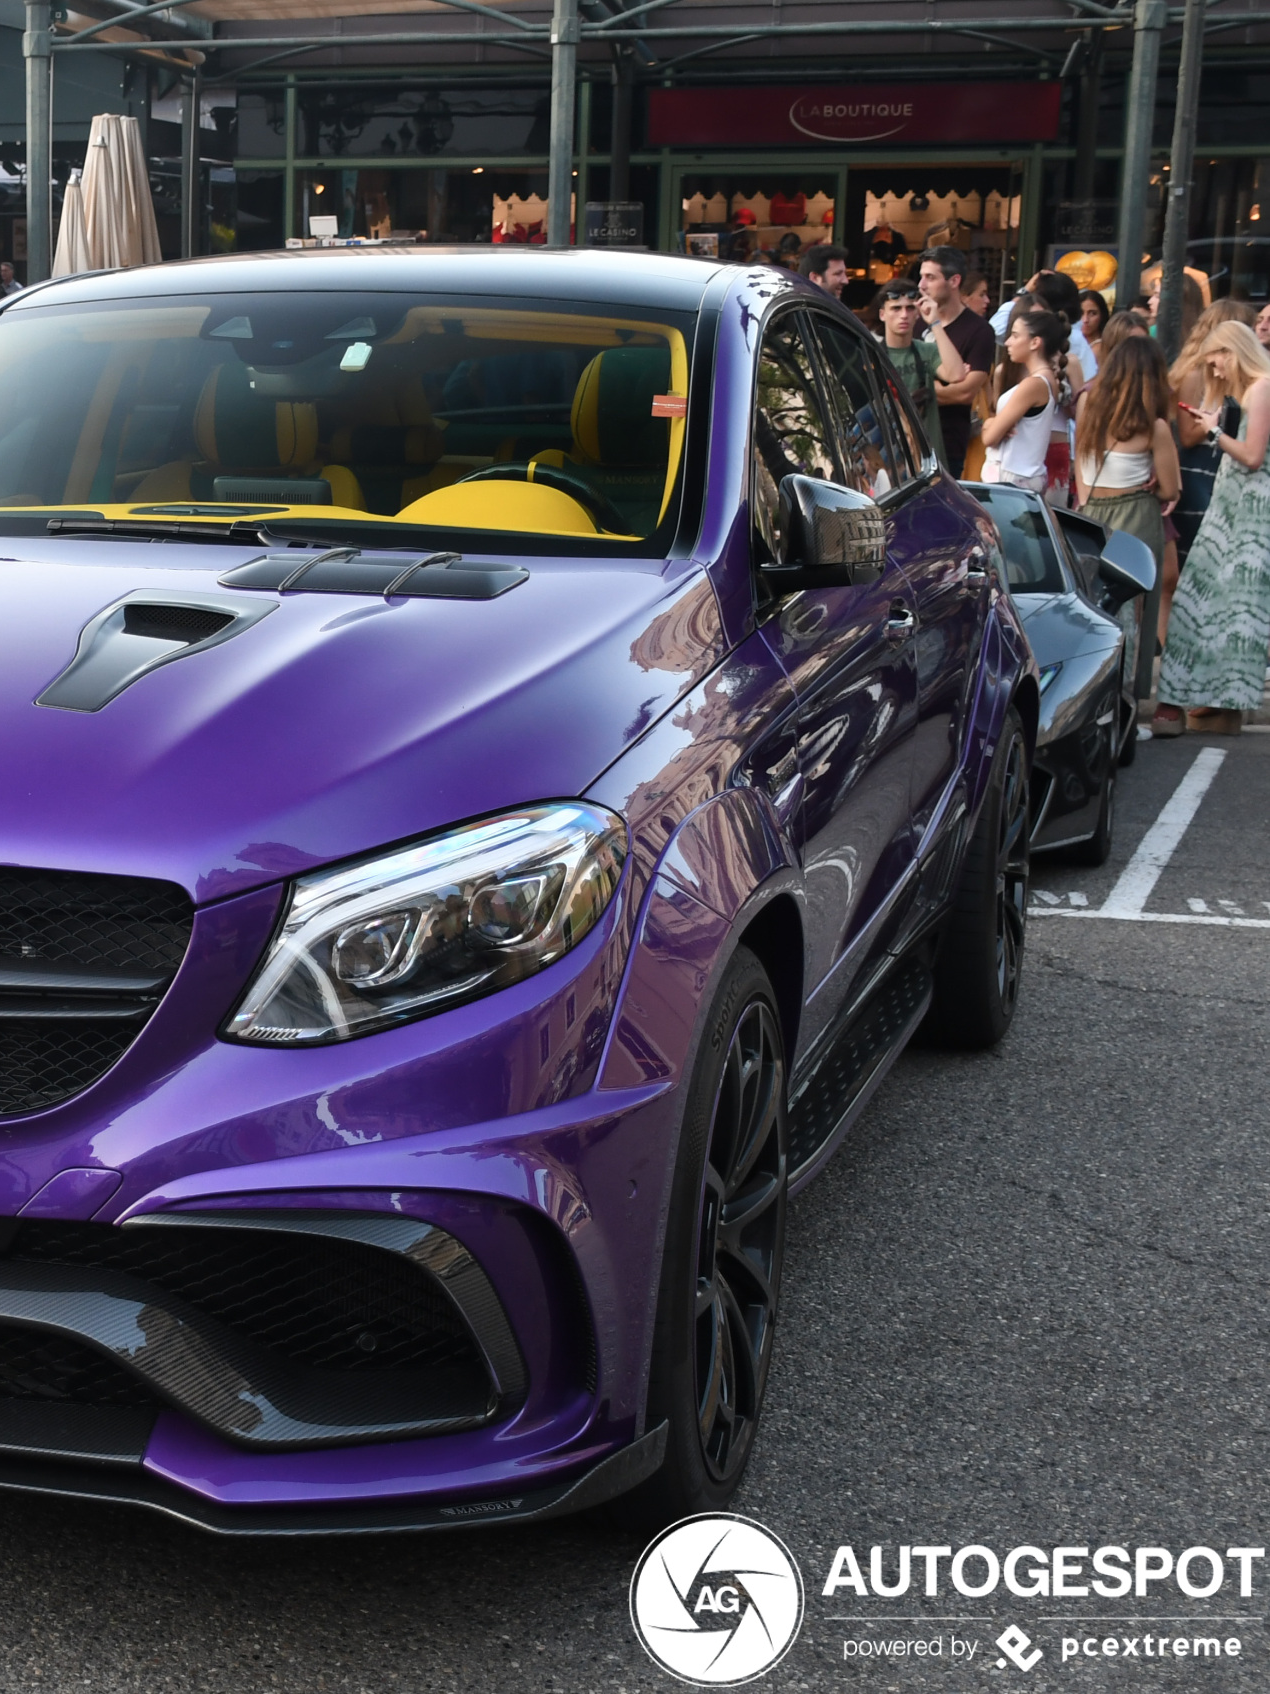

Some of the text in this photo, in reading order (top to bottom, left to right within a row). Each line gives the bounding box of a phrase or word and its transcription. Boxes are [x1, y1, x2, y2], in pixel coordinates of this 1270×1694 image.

[589, 228, 637, 237] LE CASINO
[457, 1502, 511, 1515] MANSORY
